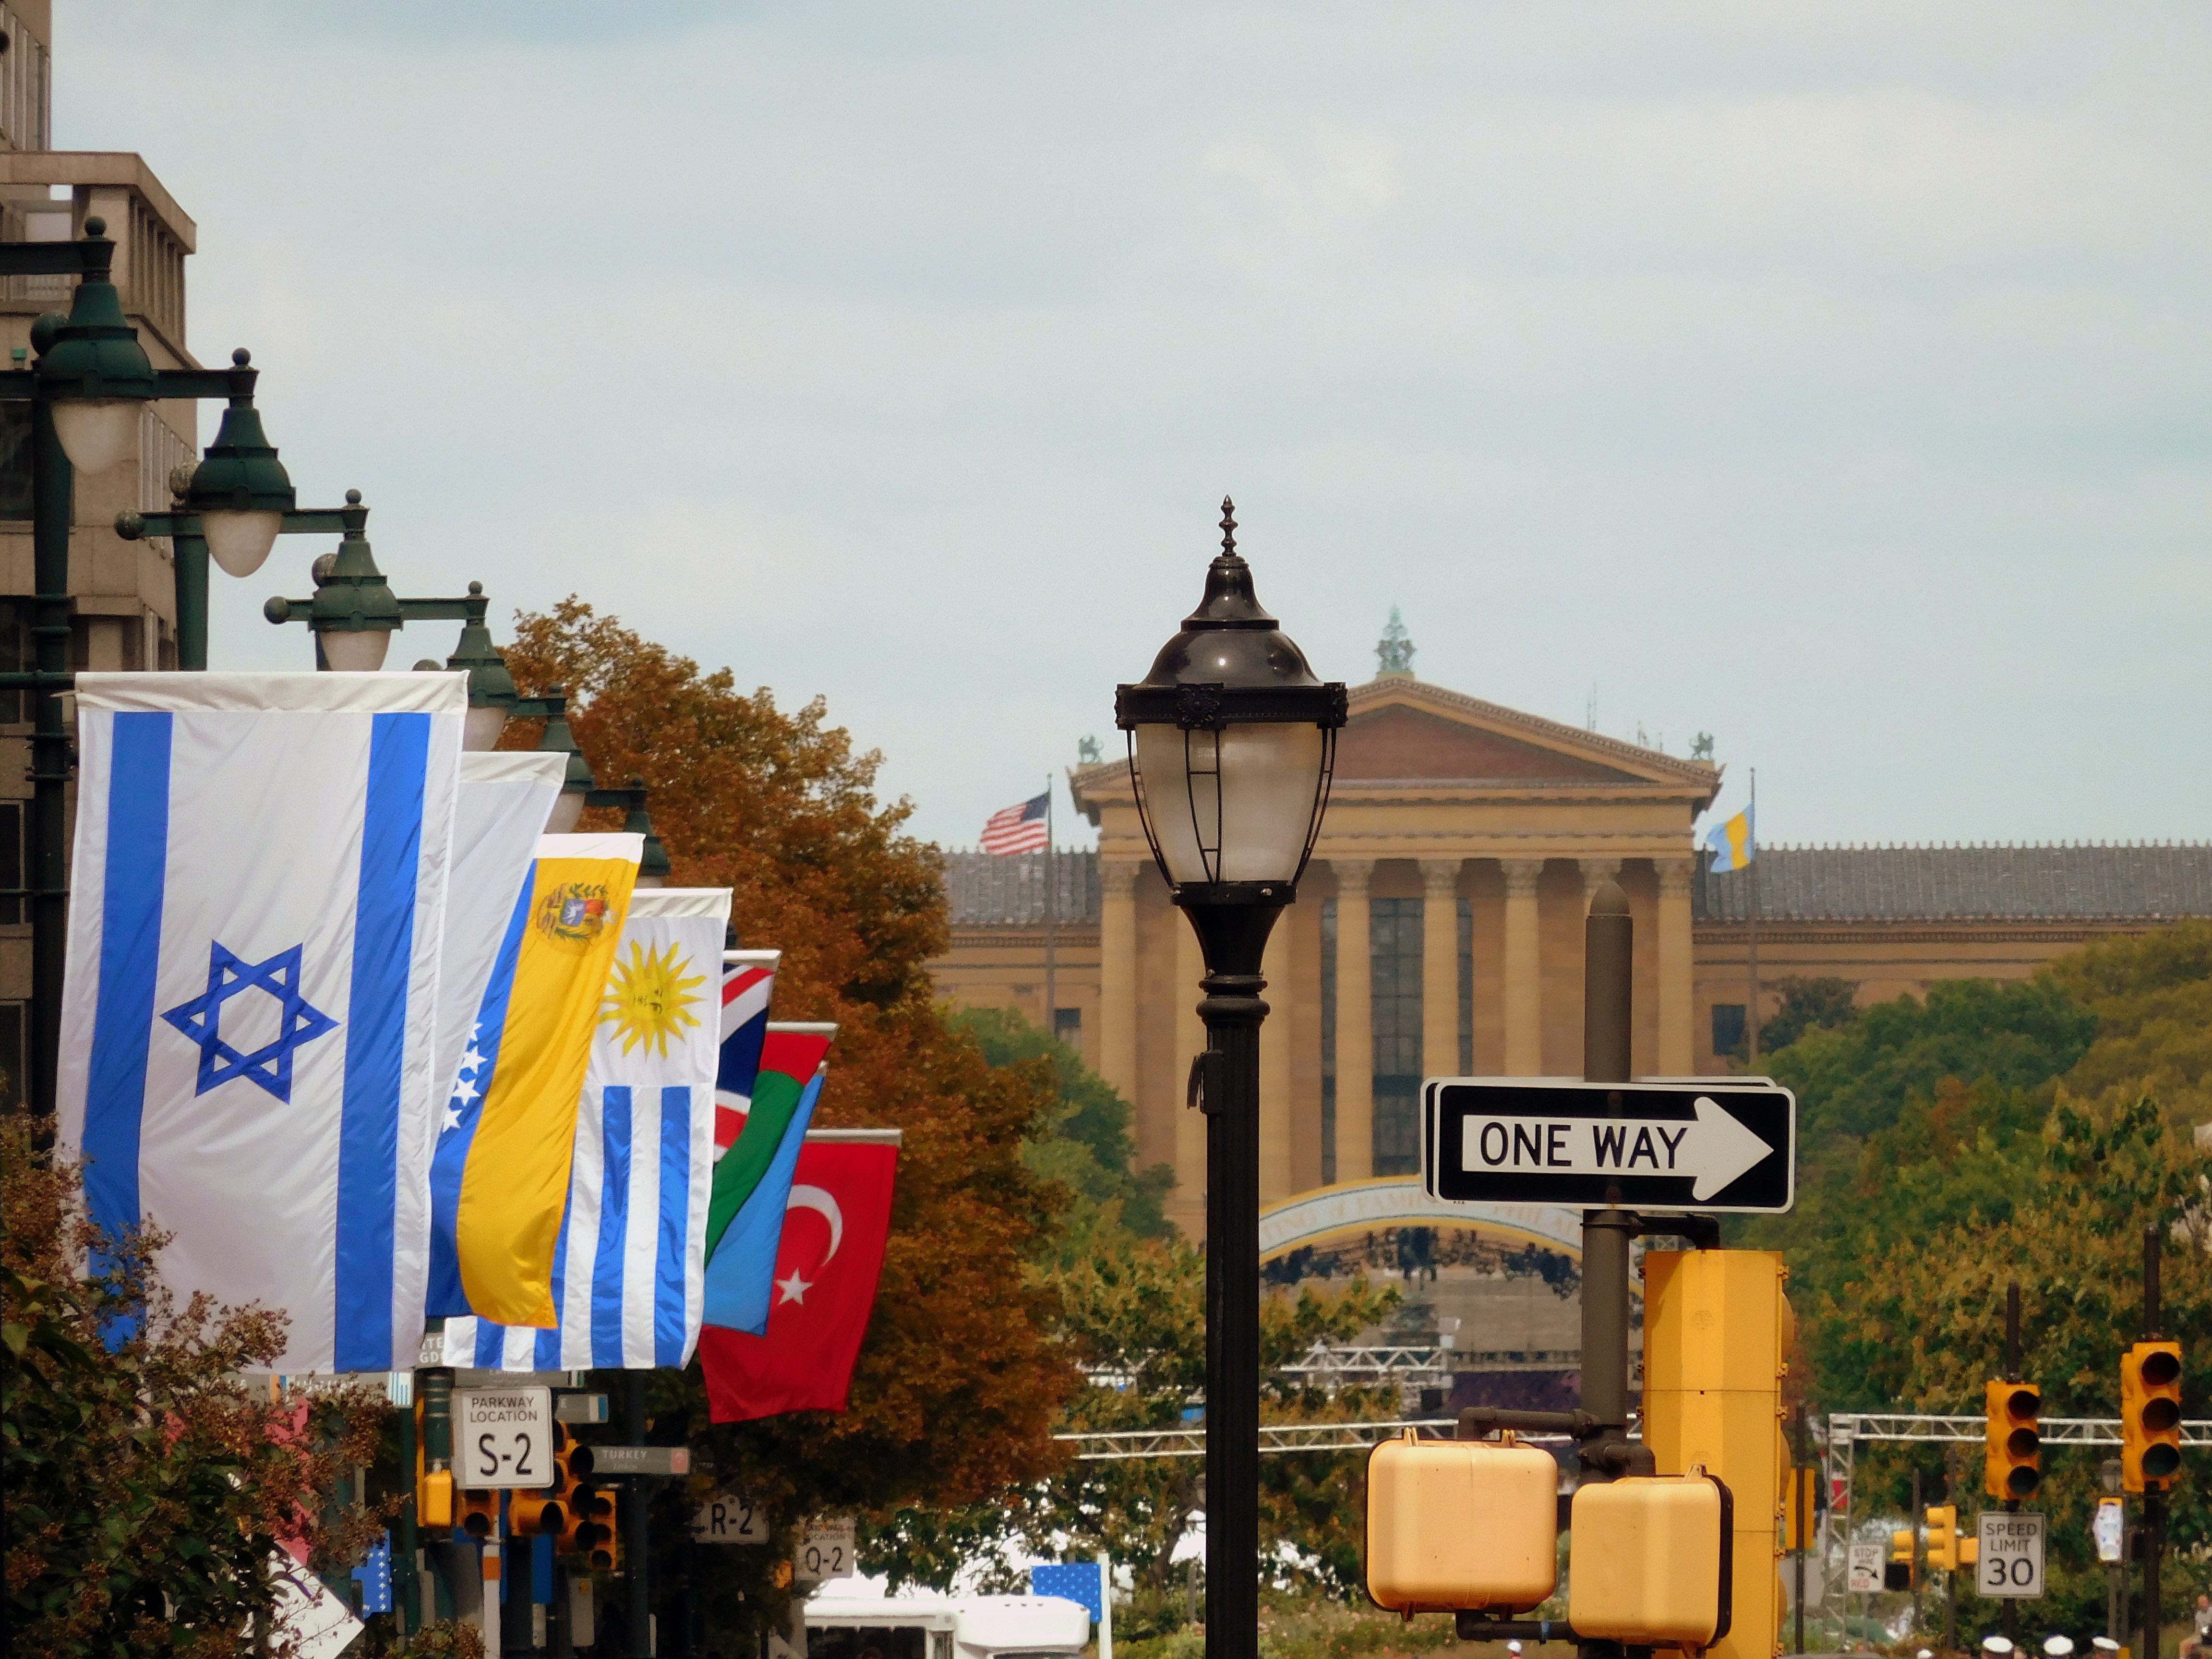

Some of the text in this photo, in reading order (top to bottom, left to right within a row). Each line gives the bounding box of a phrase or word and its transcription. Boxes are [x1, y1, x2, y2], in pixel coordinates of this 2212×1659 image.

[1480, 1122, 1688, 1169] ONE WAY
[472, 1396, 534, 1408] PARKWAY
[470, 1410, 538, 1423] LOCATION
[479, 1432, 532, 1476] S-2
[602, 1449, 647, 1460] TURKEY
[711, 1503, 753, 1535] R-2
[1986, 1523, 2037, 1536] SPEED
[1991, 1539, 2031, 1552] LIMIT
[1854, 1548, 1878, 1557] STOP
[805, 1546, 843, 1575] Q-2
[1988, 1558, 2033, 1586] 30
